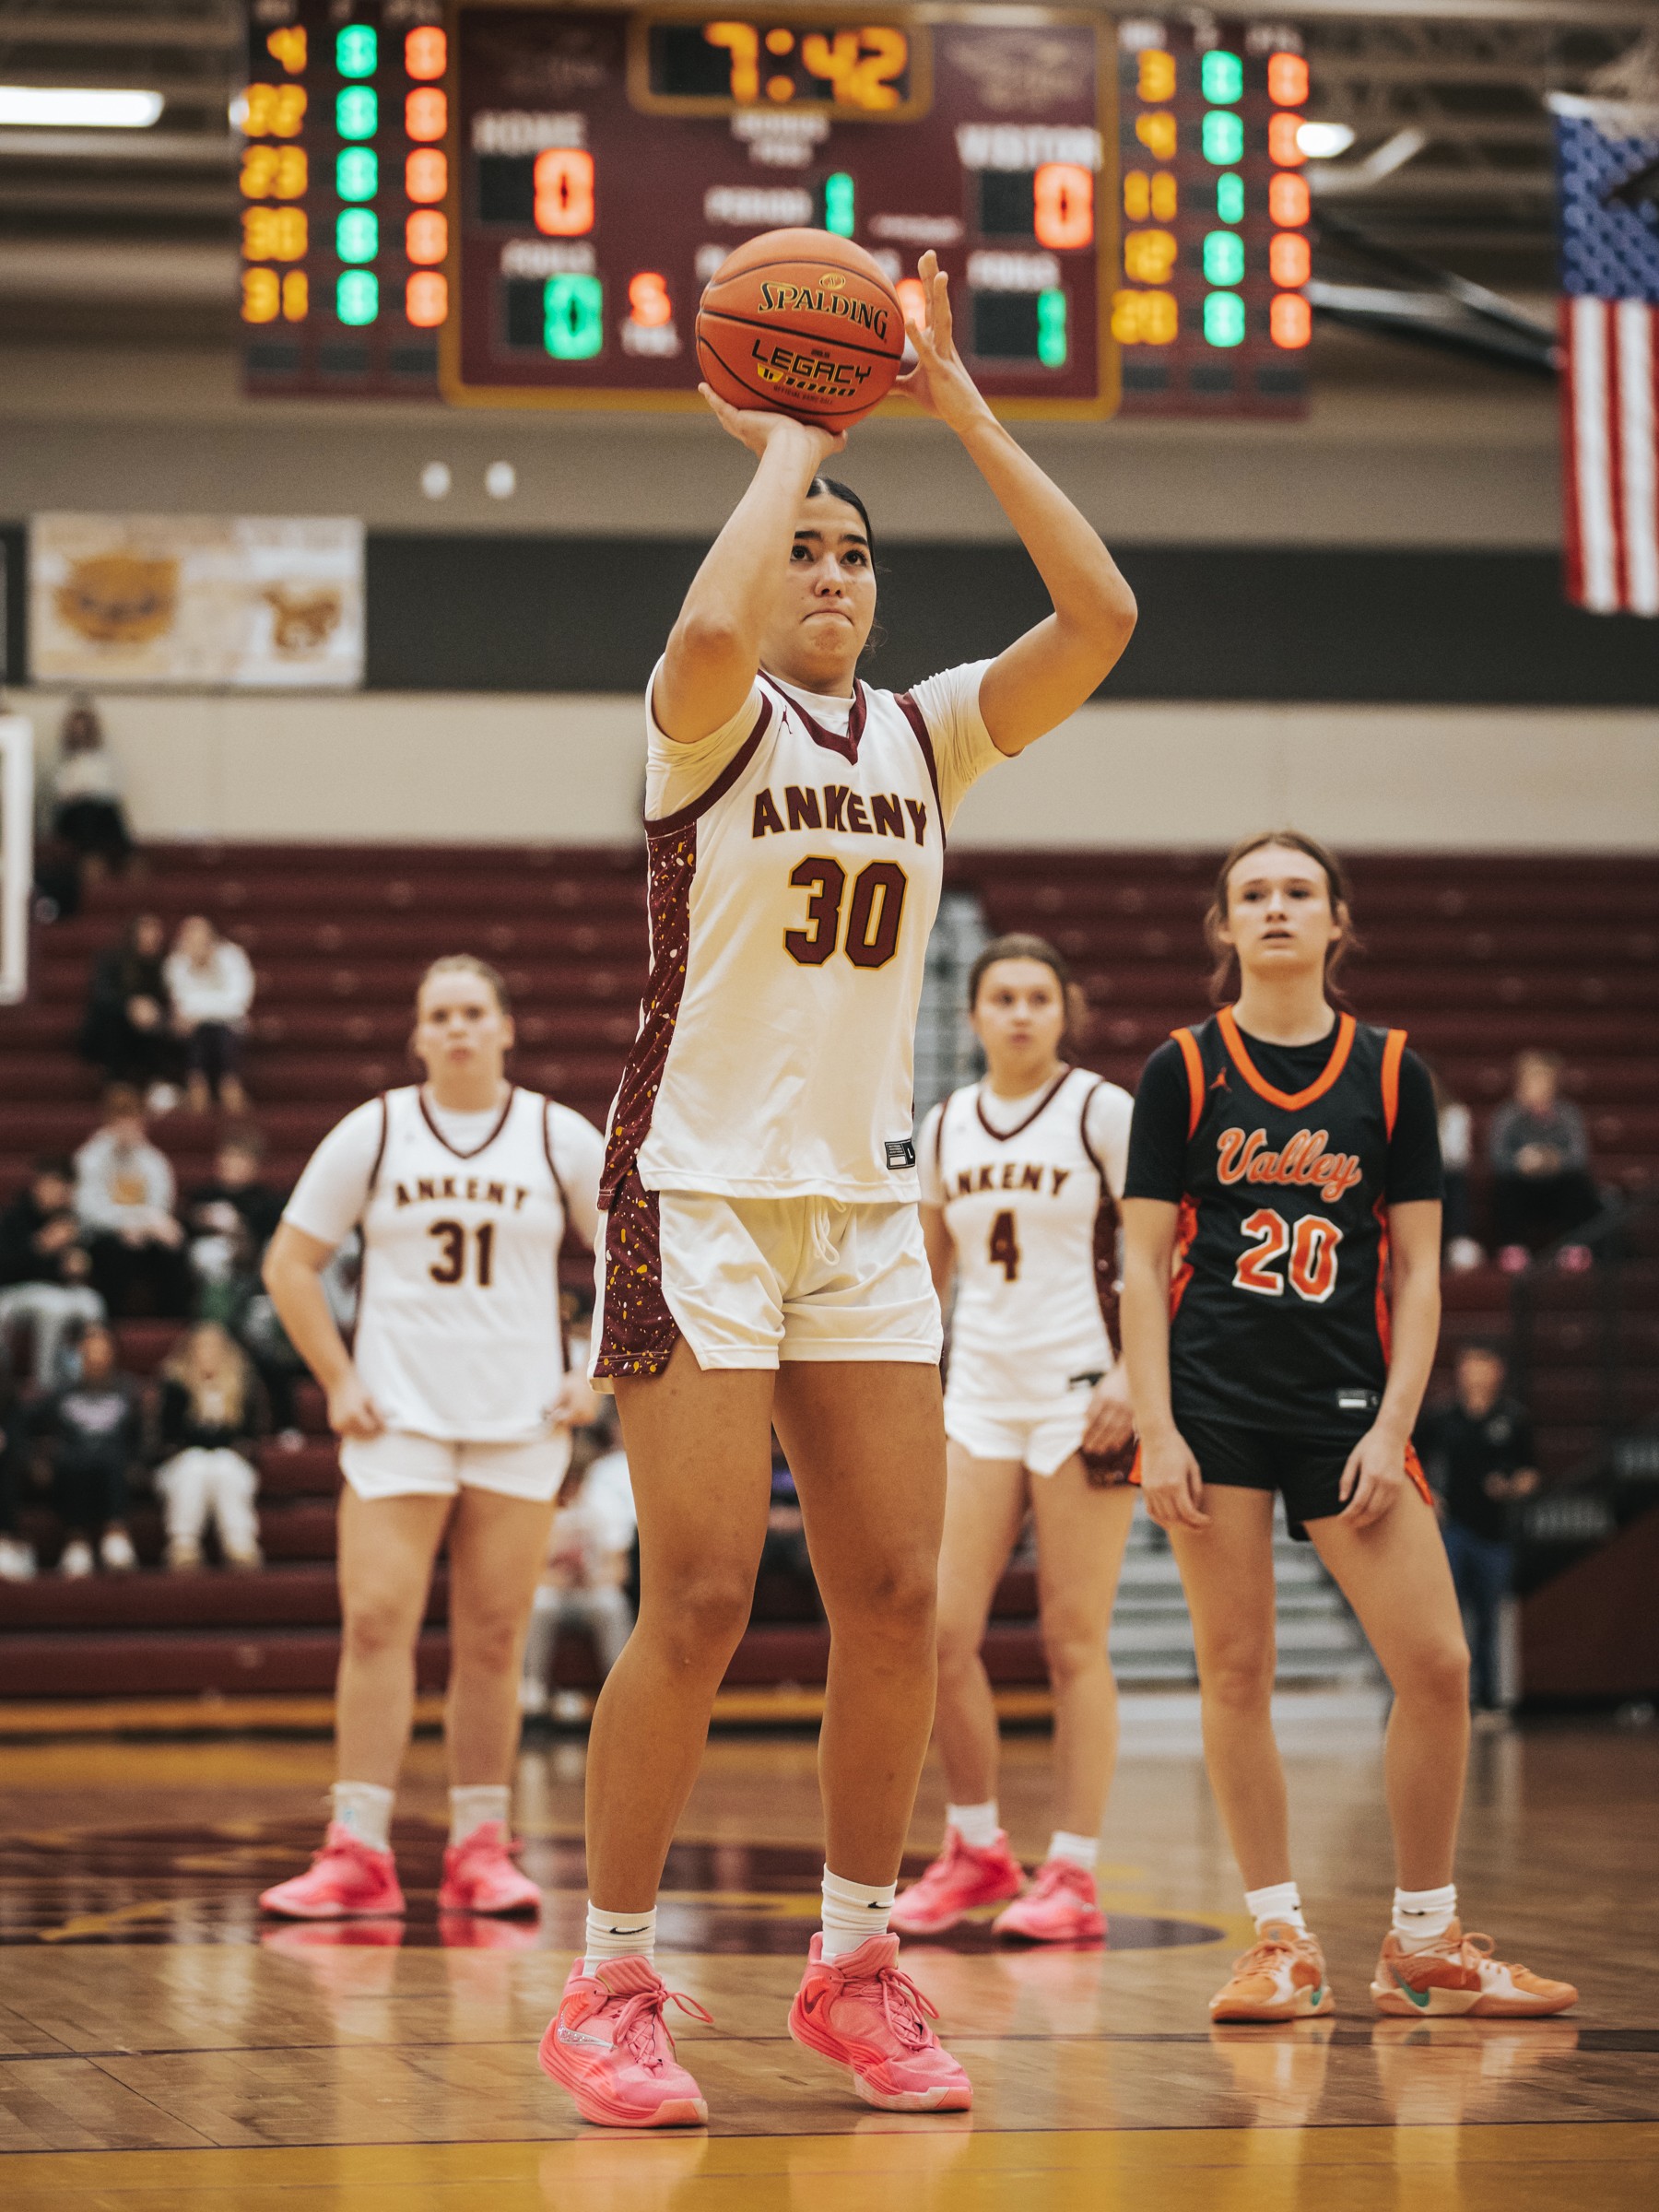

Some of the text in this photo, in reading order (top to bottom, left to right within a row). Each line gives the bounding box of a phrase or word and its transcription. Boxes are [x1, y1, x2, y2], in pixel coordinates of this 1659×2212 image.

[703, 20, 907, 111] 7:42
[533, 147, 595, 237] 0
[826, 171, 854, 239] 1
[1033, 162, 1094, 250] 0
[544, 274, 604, 360] 0
[757, 280, 888, 342] SPALDING
[1038, 288, 1066, 368] 1
[751, 338, 873, 384] LEGACY
[752, 784, 927, 847] ANKENY
[782, 854, 909, 971] 30
[394, 1176, 531, 1212] ANKENY
[944, 1162, 1071, 1202] NKENY
[1216, 1126, 1362, 1203] Valley
[427, 1217, 499, 1288] 31
[988, 1207, 1022, 1283] 4
[1232, 1207, 1344, 1303] 20
